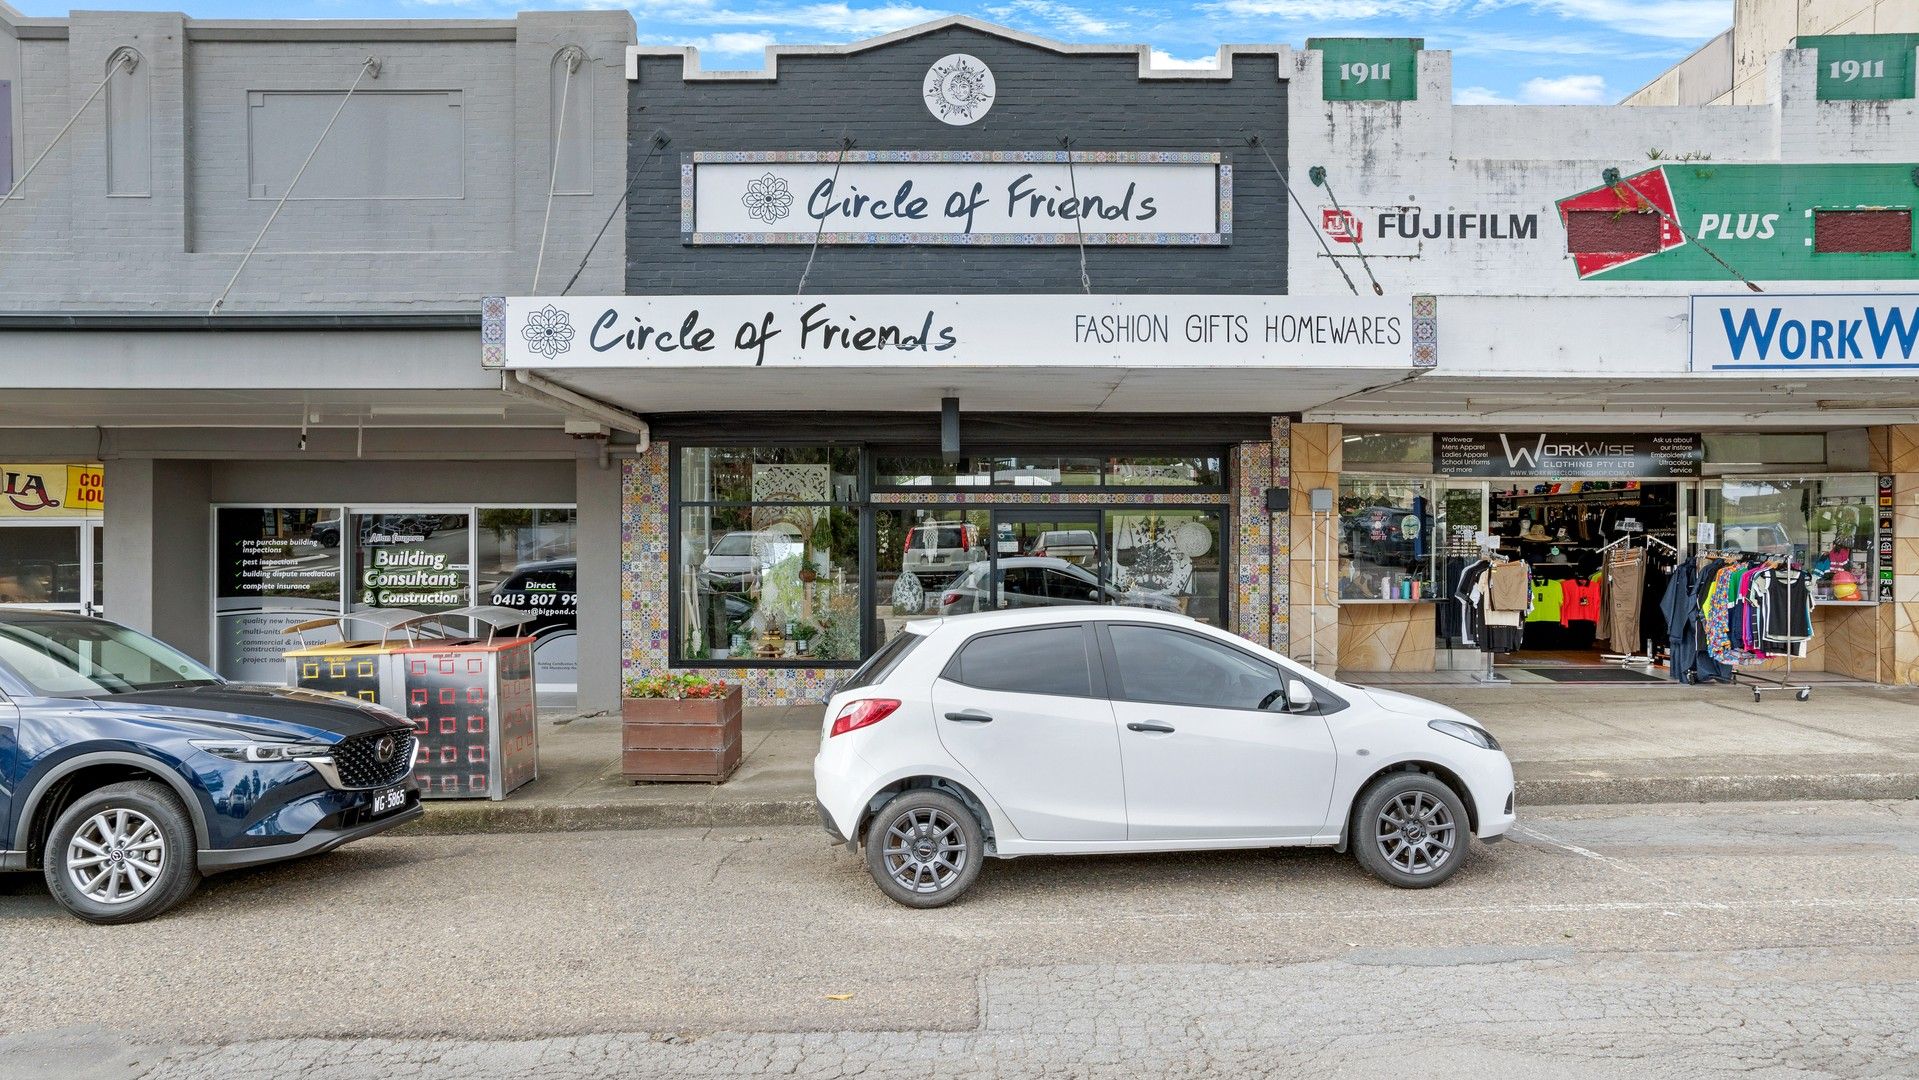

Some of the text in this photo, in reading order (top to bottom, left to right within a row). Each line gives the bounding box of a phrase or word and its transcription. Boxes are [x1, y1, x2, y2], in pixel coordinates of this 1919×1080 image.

[1340, 62, 1390, 84] 1911
[1830, 60, 1884, 82] 1911
[807, 173, 1157, 234] Circle of Friends
[1378, 214, 1538, 239] FUJIFILM
[1697, 214, 1779, 240] PLUS
[588, 303, 957, 366] Circle of Friends
[1075, 314, 1401, 346] FASHION GIFTS HOMEWARES
[80, 473, 104, 488] CO
[290, 539, 318, 547] building
[375, 550, 446, 570] Building
[364, 569, 458, 587] Consultant
[364, 590, 458, 604] & Construction
[493, 594, 577, 605] 0413 807 99
